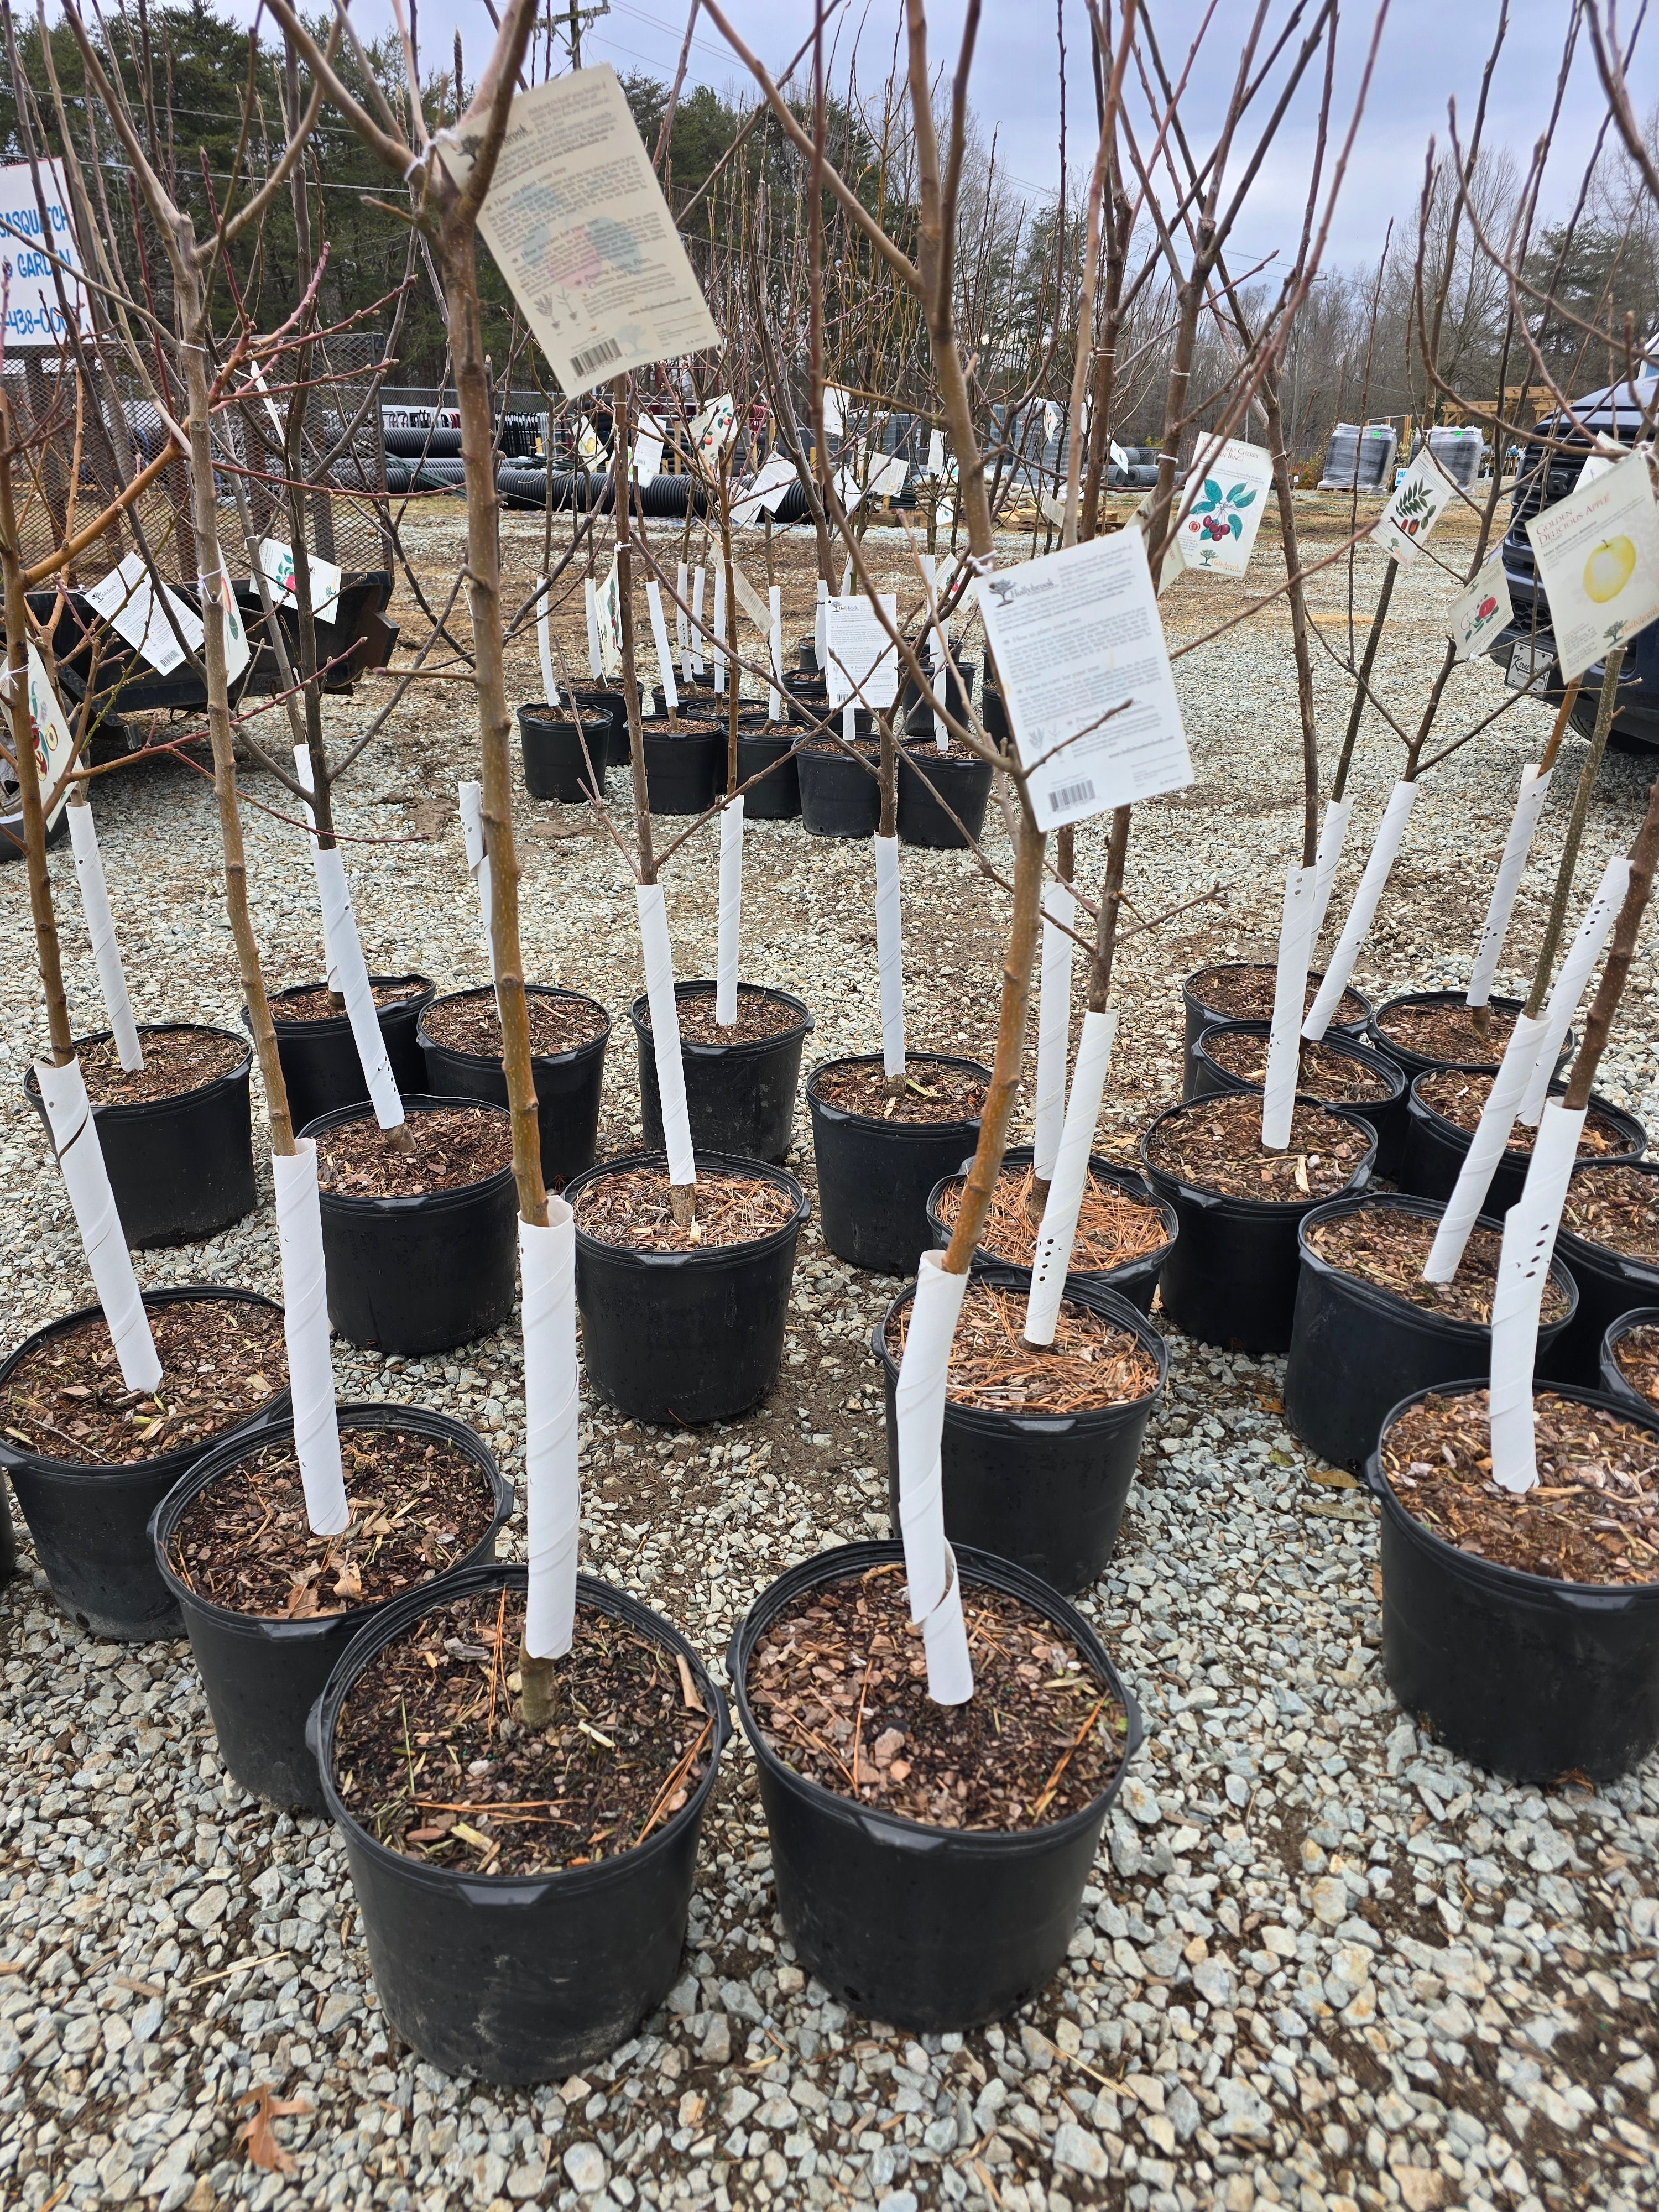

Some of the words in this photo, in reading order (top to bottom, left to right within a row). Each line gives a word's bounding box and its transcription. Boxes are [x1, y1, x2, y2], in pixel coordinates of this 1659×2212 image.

[0, 206, 66, 238] SASQUCH
[17, 249, 71, 278] GARDN
[1237, 447, 1260, 459] CHERRY
[1536, 509, 1573, 535] GOLDEN
[1538, 513, 1583, 545] DELICIOUS
[1586, 495, 1610, 515] APPLE
[1211, 559, 1239, 570] Hollybrook
[1010, 577, 1055, 599] Hollybrook
